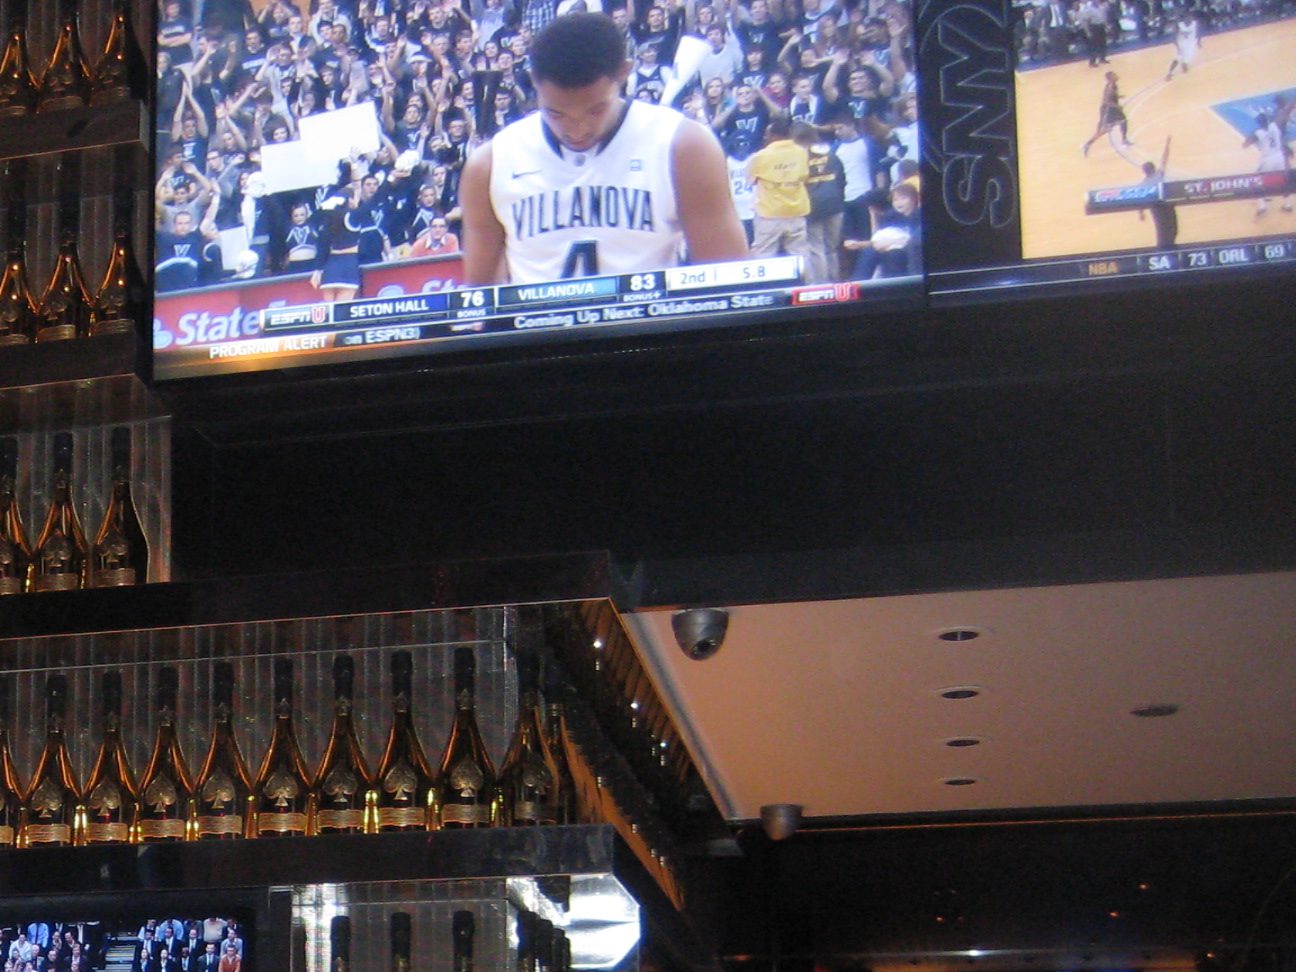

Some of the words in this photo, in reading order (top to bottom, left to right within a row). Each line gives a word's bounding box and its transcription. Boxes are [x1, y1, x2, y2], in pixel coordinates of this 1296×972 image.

[511, 185, 655, 241] VILLANOVA
[1088, 261, 1118, 276] NBA
[1148, 255, 1171, 271] SA
[1188, 252, 1207, 267] 73
[1218, 248, 1249, 264] ORL
[1264, 244, 1285, 259] 69
[349, 302, 393, 319] SETON
[395, 299, 429, 313] HALL
[460, 290, 484, 308] 76
[517, 282, 596, 301] VILLANOVA
[630, 273, 655, 291] 83
[679, 271, 706, 286] 2nd
[175, 305, 262, 348] State
[209, 338, 280, 360] PROGRAM
[284, 334, 328, 350] ALERT
[514, 313, 576, 329] Coming
[576, 310, 600, 325] Up
[647, 299, 728, 317] Oklahoma
[730, 294, 775, 309] State
